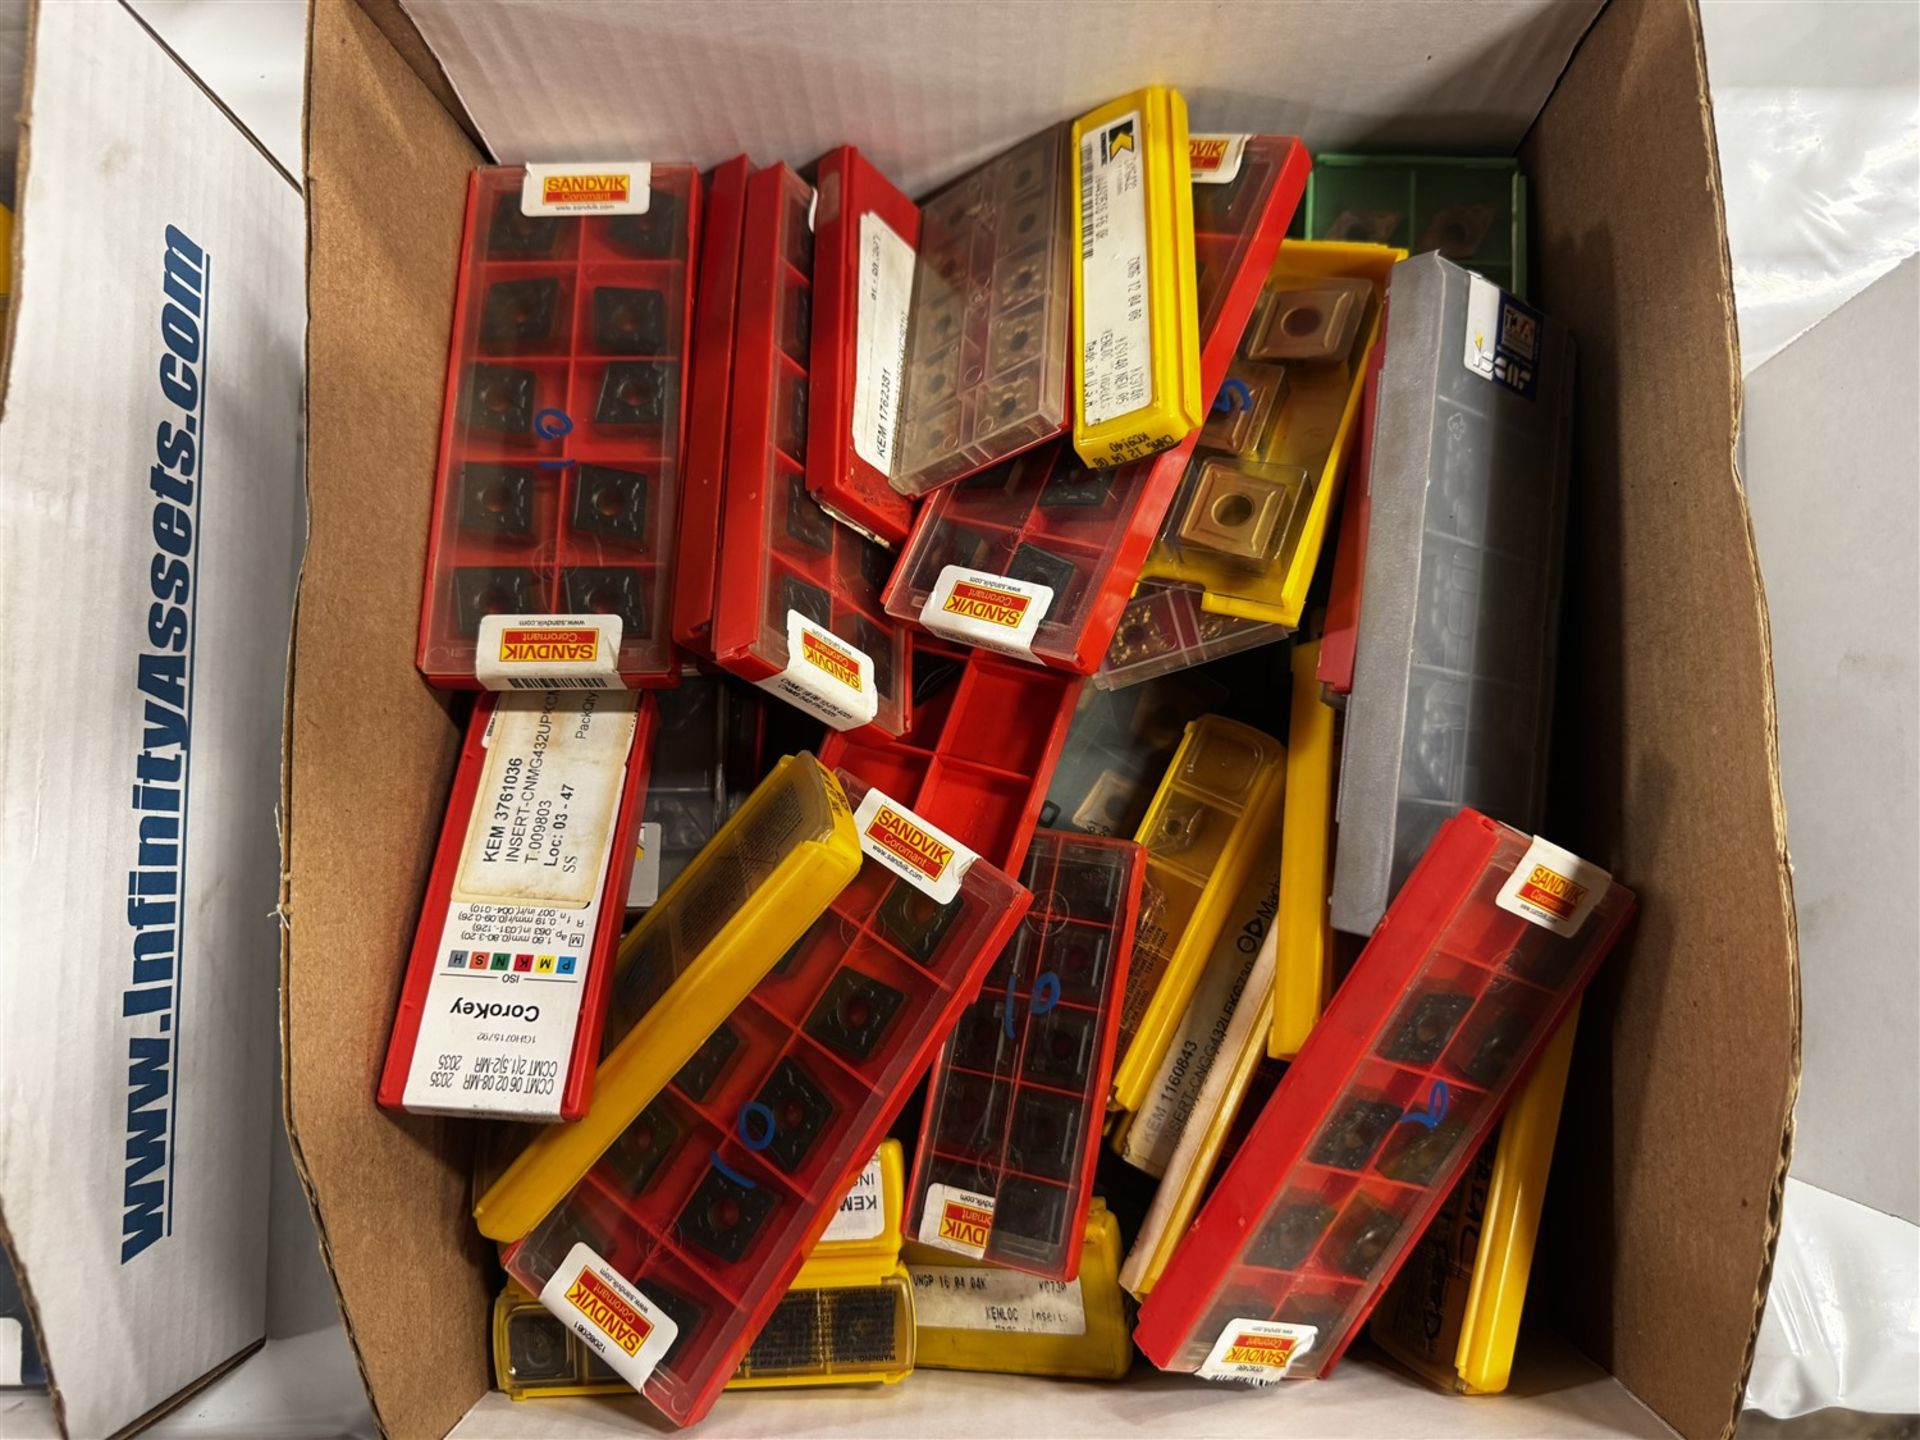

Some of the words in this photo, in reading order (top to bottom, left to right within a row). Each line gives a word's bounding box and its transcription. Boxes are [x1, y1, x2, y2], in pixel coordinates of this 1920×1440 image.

[1189, 141, 1224, 156] DVIK
[548, 177, 625, 191] SANDVIK
[562, 192, 610, 201] Coromant
[876, 427, 888, 458] KEM
[968, 589, 1012, 606] Coromant
[948, 597, 1020, 624] SANDVIK
[523, 632, 577, 642] Coromant
[504, 644, 593, 659] SANDVIK
[804, 646, 859, 688] SANDVIK
[121, 223, 205, 1264] www.InfinityAssets.com
[561, 784, 575, 801] 47
[483, 826, 505, 863] KEM
[495, 757, 522, 821] 3761036
[553, 813, 567, 829] 03
[525, 800, 552, 863] T.009803
[878, 809, 950, 865] SANDVIK
[544, 834, 563, 867] Loc:
[883, 833, 928, 868] Coromant
[563, 856, 577, 873] SS
[872, 845, 923, 880] www.sandvik.com
[1530, 868, 1584, 904] SANDVIK
[453, 954, 463, 964] H
[475, 955, 484, 965] S
[496, 957, 505, 966] N
[520, 959, 529, 967] K
[540, 959, 551, 969] M
[562, 961, 571, 970] P
[502, 974, 520, 983] ISO
[450, 997, 540, 1022] CoroKey
[438, 1054, 463, 1071] 2035
[527, 1060, 558, 1078] CCMT
[430, 1071, 454, 1088] 2035
[462, 1073, 494, 1091] 08-MR
[495, 1076, 508, 1092] 02
[509, 1077, 523, 1093] 06
[523, 1078, 554, 1095] CCMT
[1144, 1106, 1167, 1142] KEM
[1160, 1040, 1197, 1107] 1160843
[840, 1196, 877, 1211] KEM
[962, 1209, 993, 1224] omant
[945, 1220, 987, 1245] DVIK
[593, 1283, 635, 1324] Coromant
[570, 1283, 640, 1351] SANDVIK
[985, 1306, 1018, 1321] KENLOC
[1226, 1347, 1288, 1365] SANDVIK
